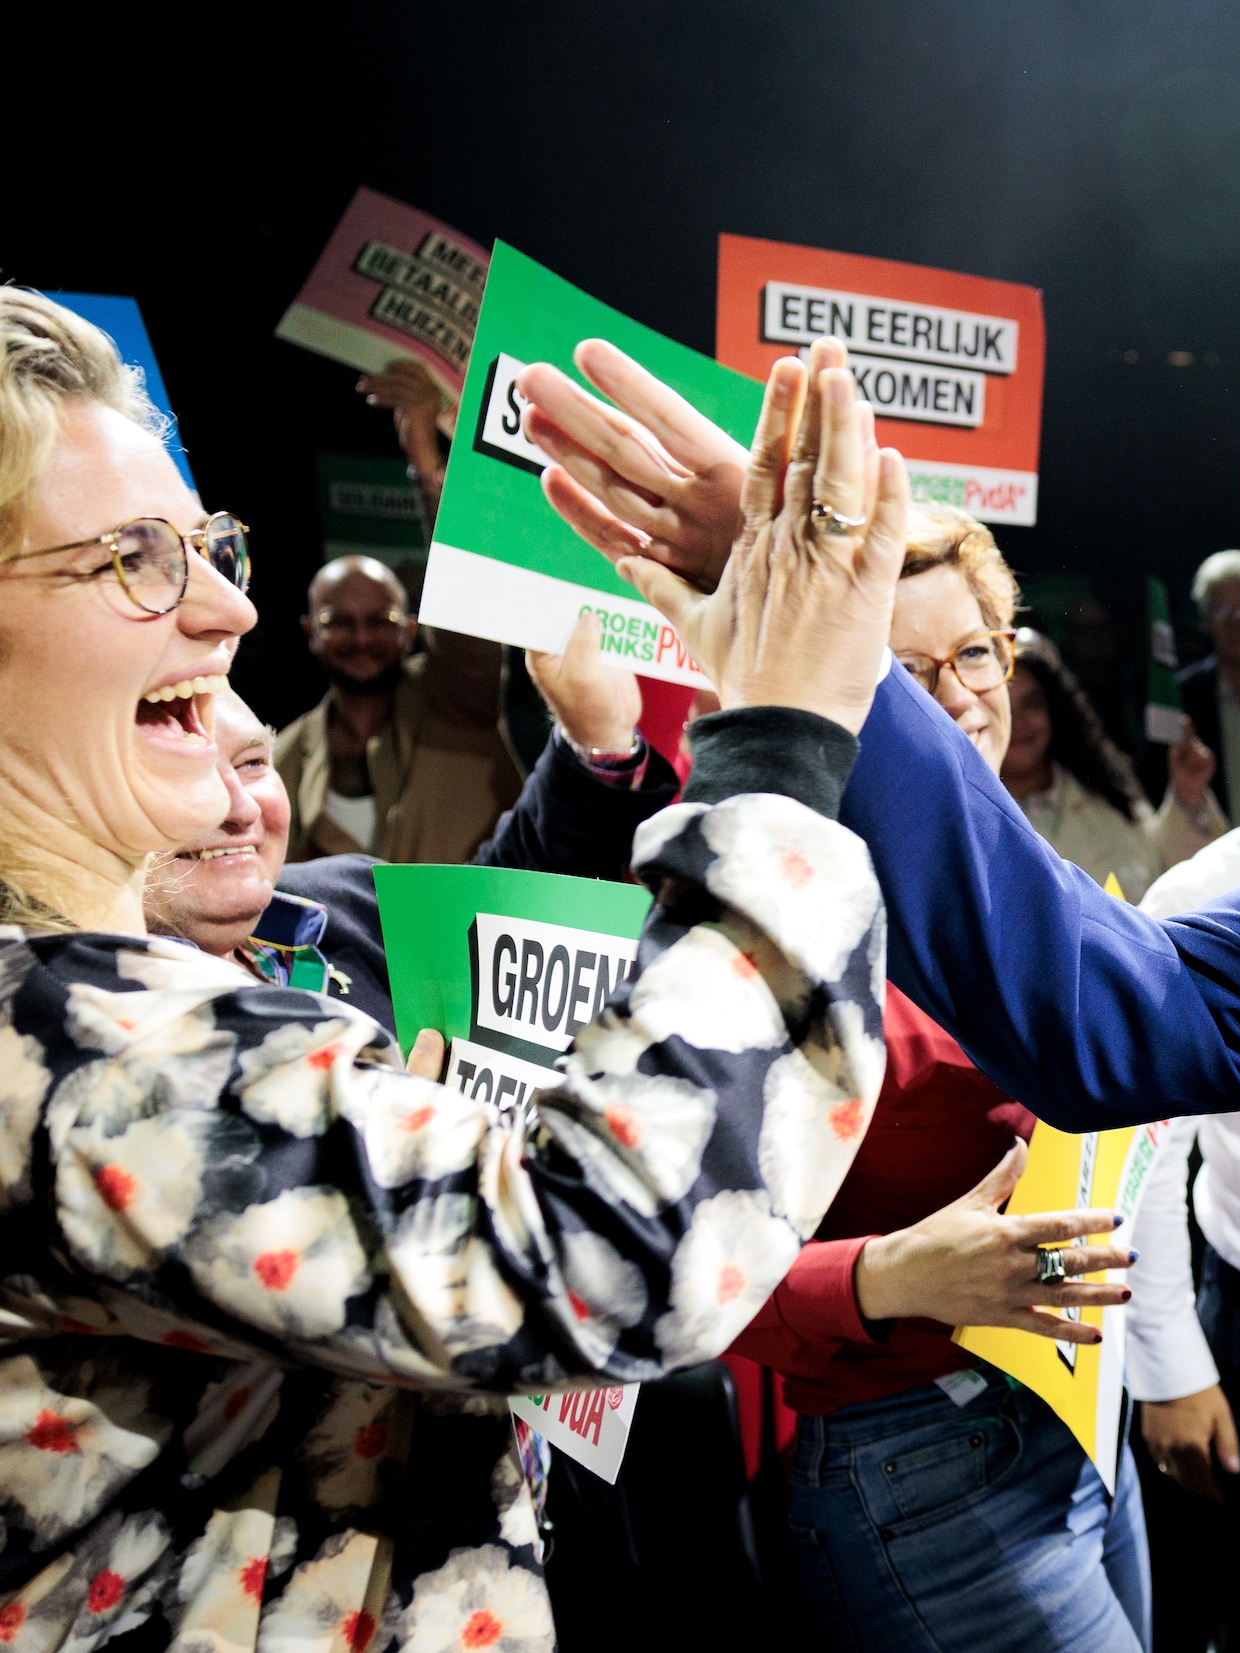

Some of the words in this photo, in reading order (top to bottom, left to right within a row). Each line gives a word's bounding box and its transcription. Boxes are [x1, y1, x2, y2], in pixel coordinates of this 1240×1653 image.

[781, 294, 854, 338] EEN
[866, 307, 1004, 362] EERLIJK
[851, 365, 975, 415] KOMEN
[600, 632, 654, 662] INKS
[492, 934, 638, 1037] GROEN
